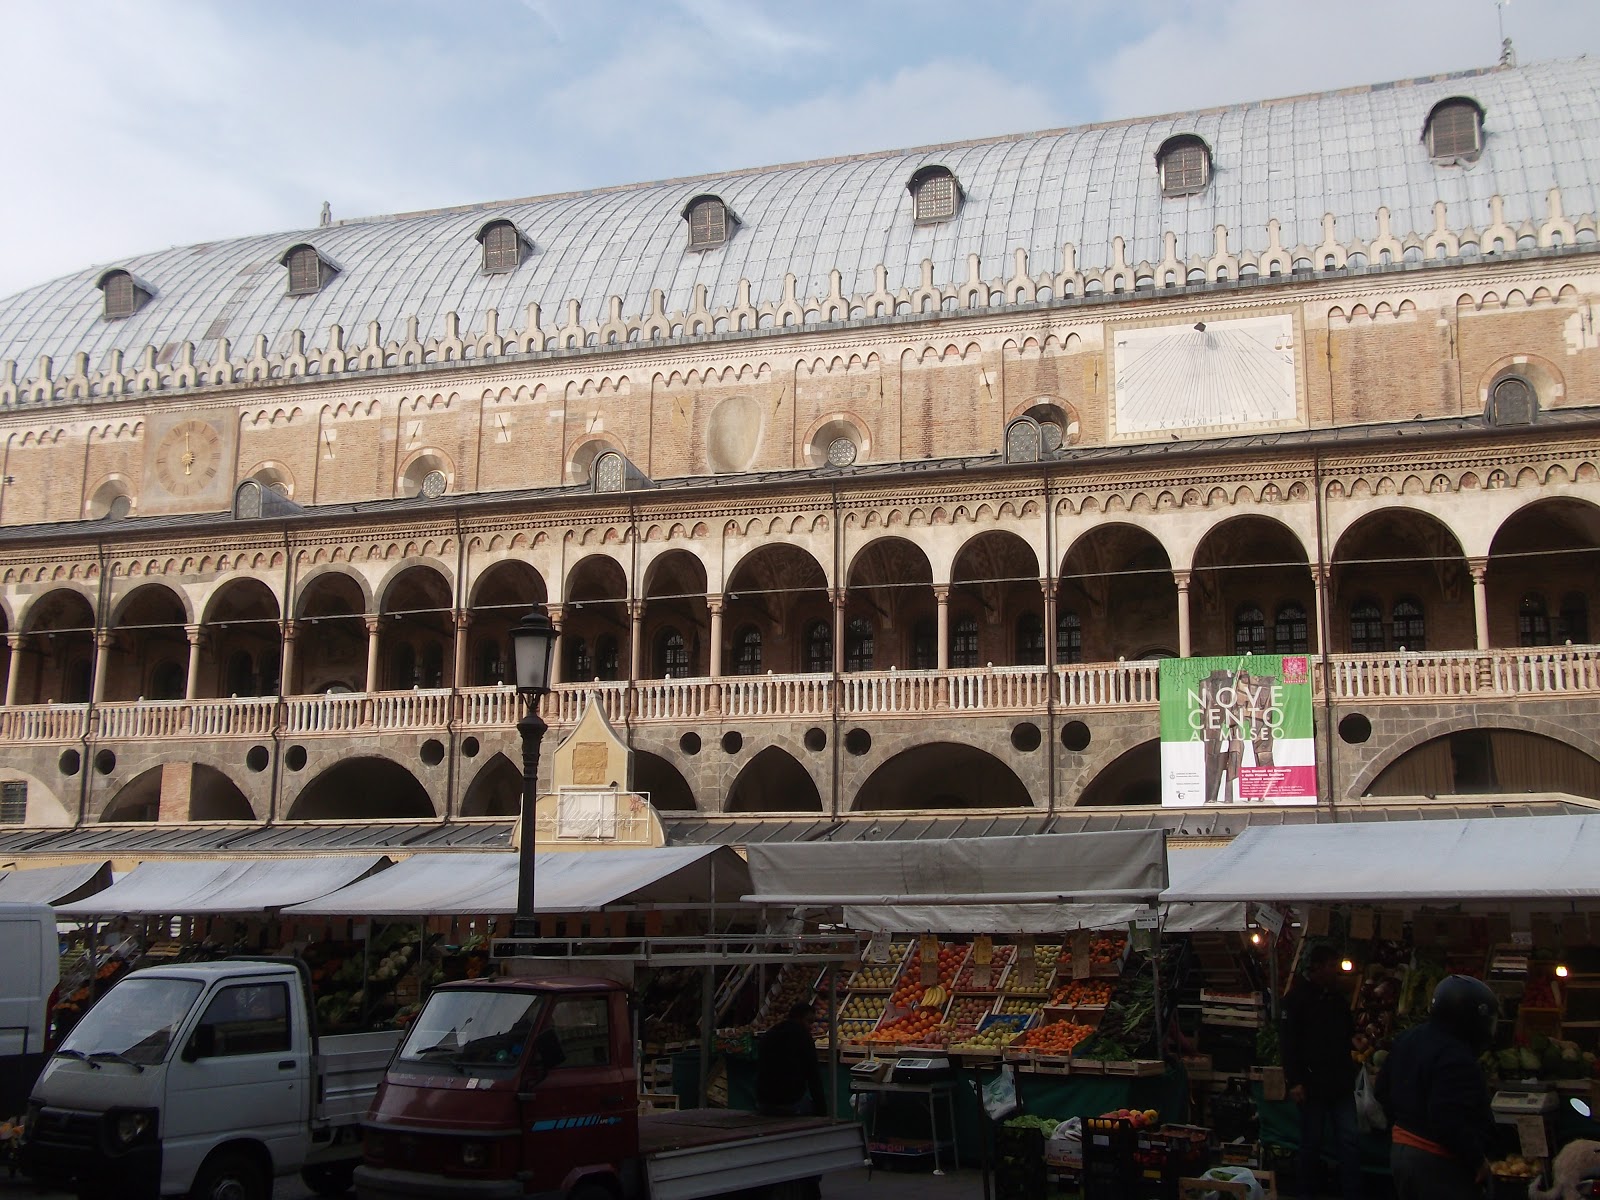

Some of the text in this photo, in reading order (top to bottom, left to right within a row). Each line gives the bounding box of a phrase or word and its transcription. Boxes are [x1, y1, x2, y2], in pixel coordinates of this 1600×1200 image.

[1187, 686, 1284, 709] NOVE
[1188, 707, 1285, 730] CENTO
[1190, 727, 1284, 742] AL MUSEO
